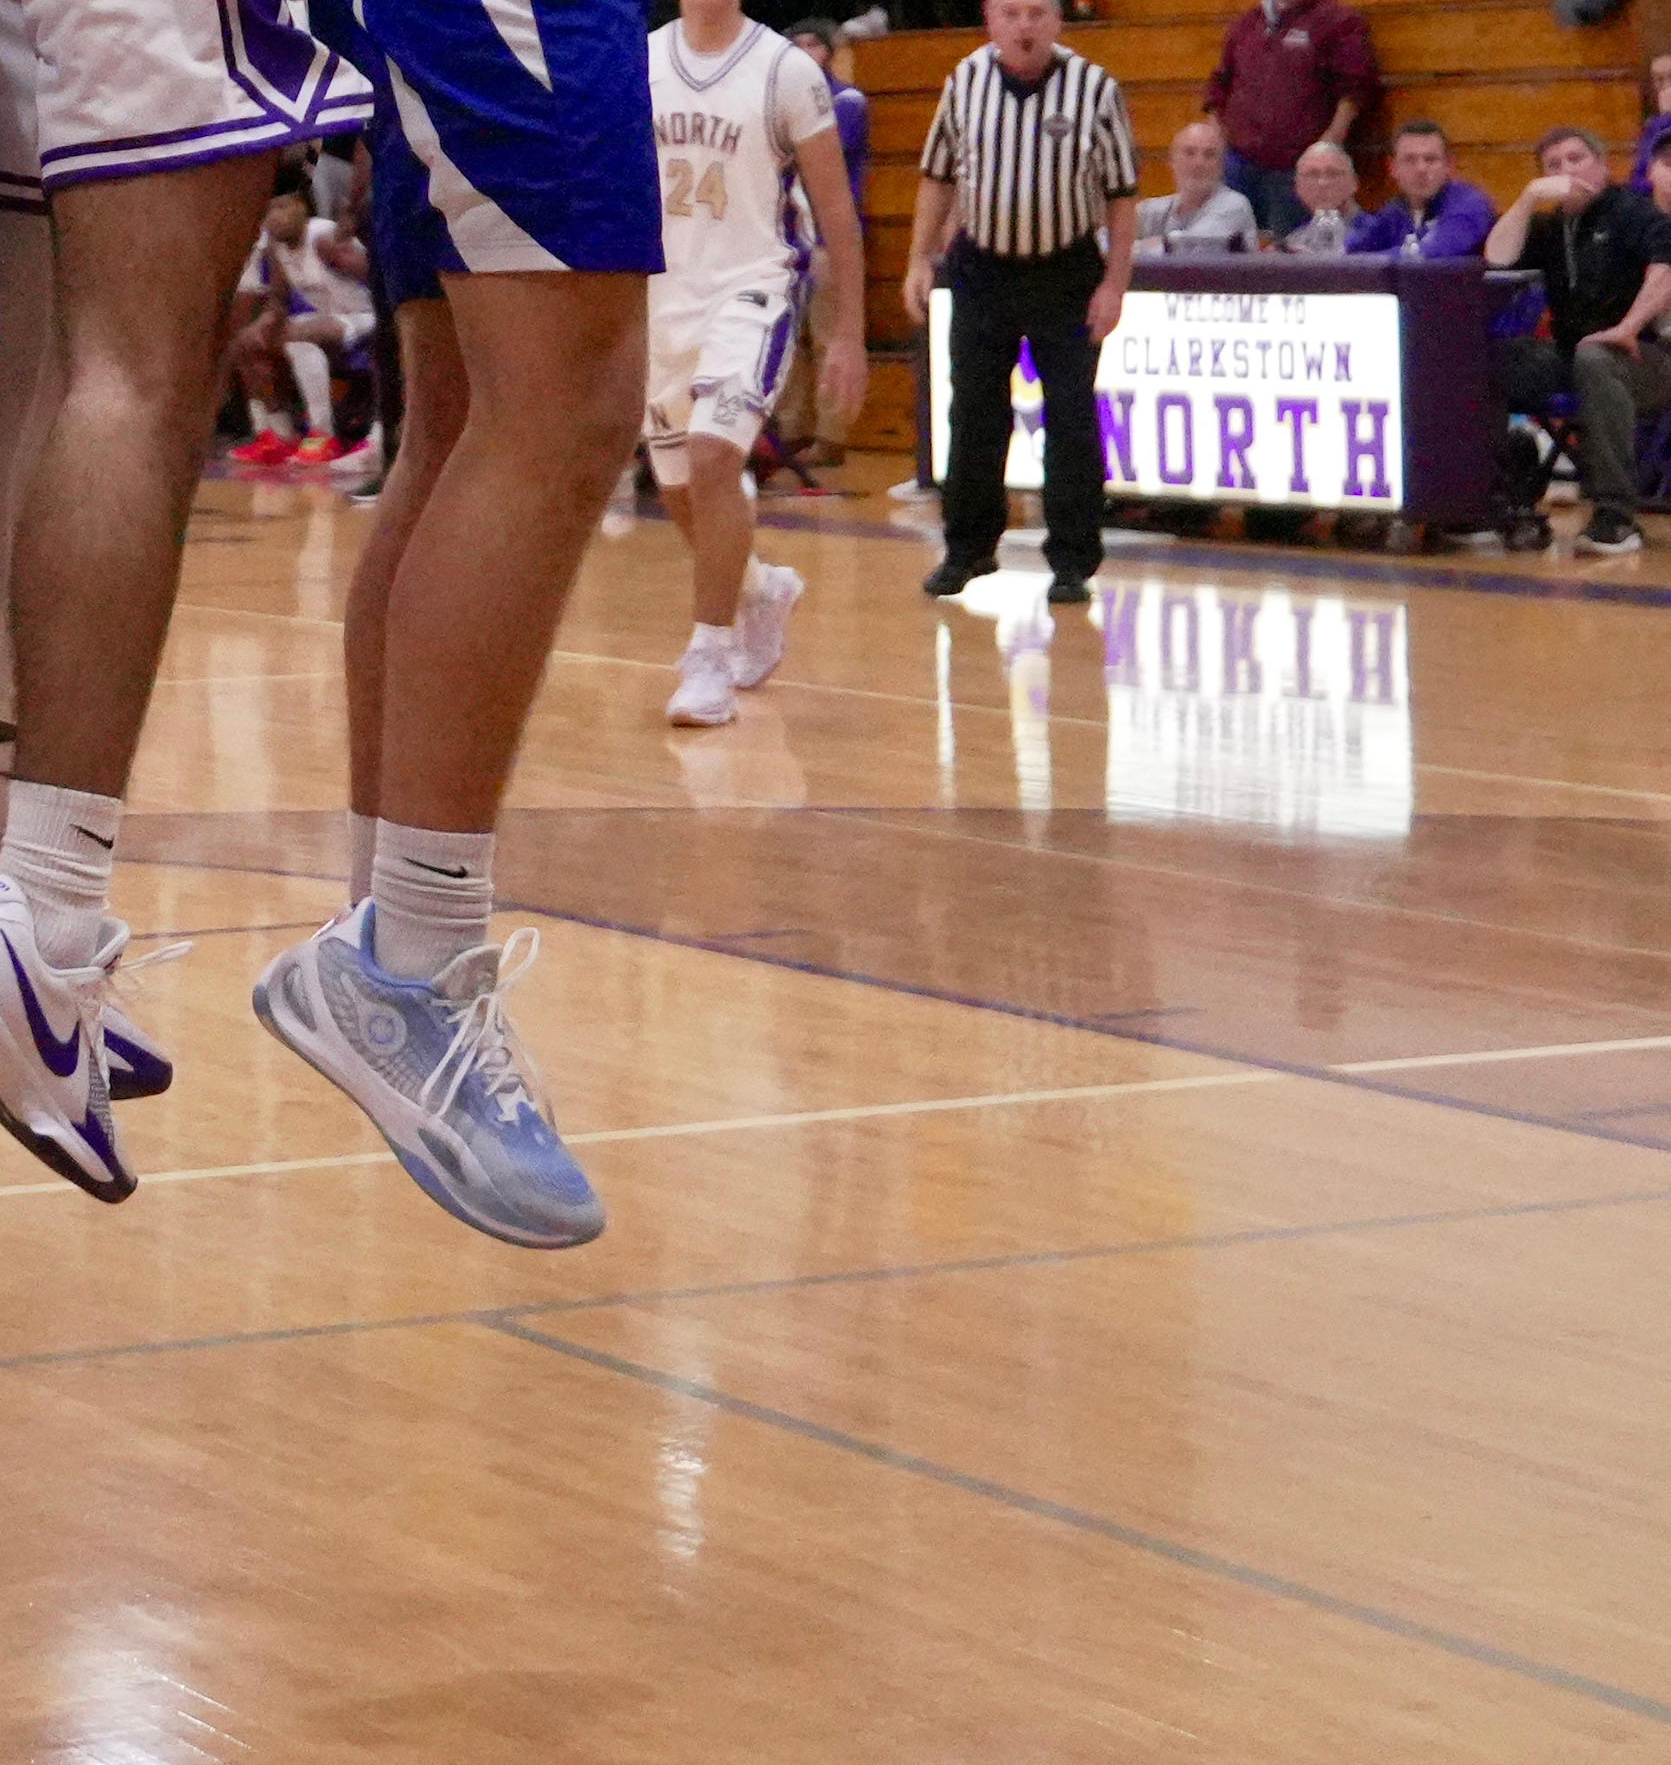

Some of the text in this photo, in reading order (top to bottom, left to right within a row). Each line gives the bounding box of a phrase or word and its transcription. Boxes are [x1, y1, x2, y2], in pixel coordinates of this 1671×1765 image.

[653, 111, 743, 156] NORTH
[664, 157, 728, 221] 24
[1166, 292, 1269, 324] WELCOME
[1122, 336, 1352, 383] CLARKSTOWN
[1096, 389, 1392, 499] NORTH
